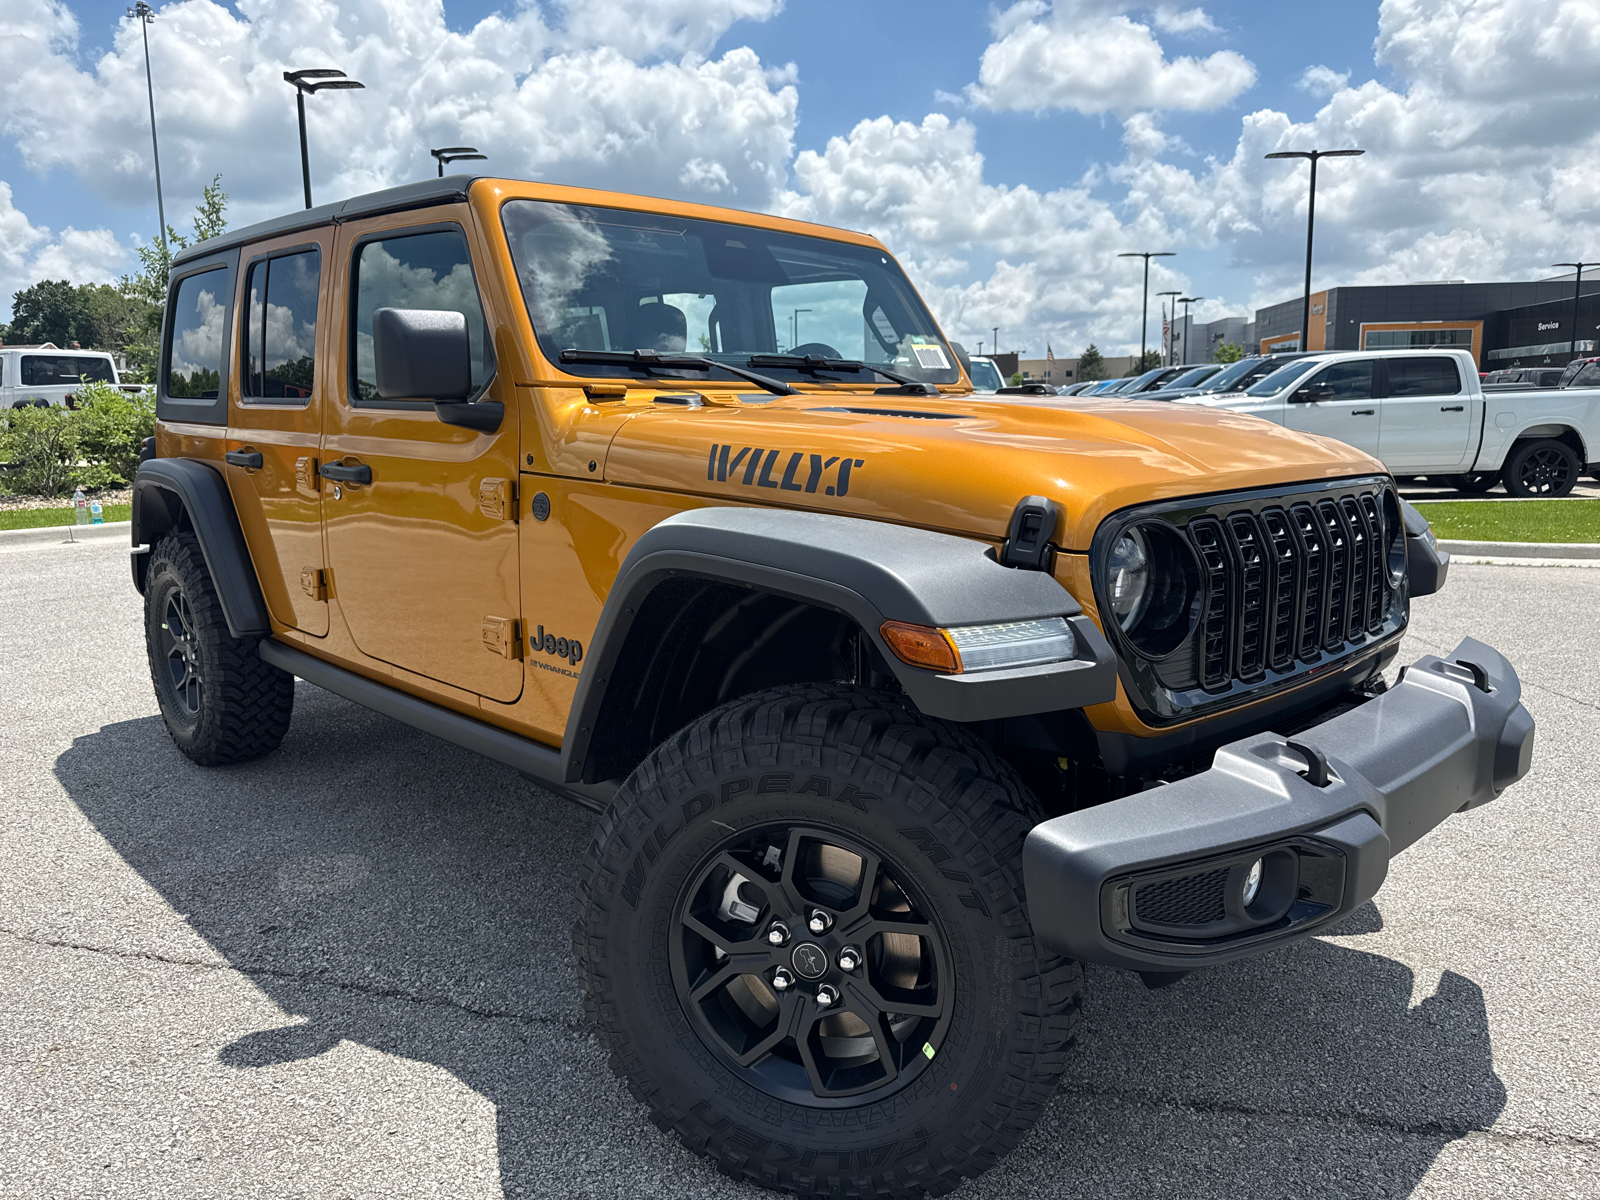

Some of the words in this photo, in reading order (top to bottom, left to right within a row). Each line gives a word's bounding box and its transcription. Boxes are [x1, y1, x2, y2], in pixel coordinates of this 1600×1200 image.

[1537, 320, 1559, 331] Service
[707, 443, 865, 498] WILLYS
[530, 624, 583, 666] Jeep
[538, 661, 581, 680] WRANGLE
[618, 772, 882, 910] WILDPEAK
[895, 828, 993, 919] M/T
